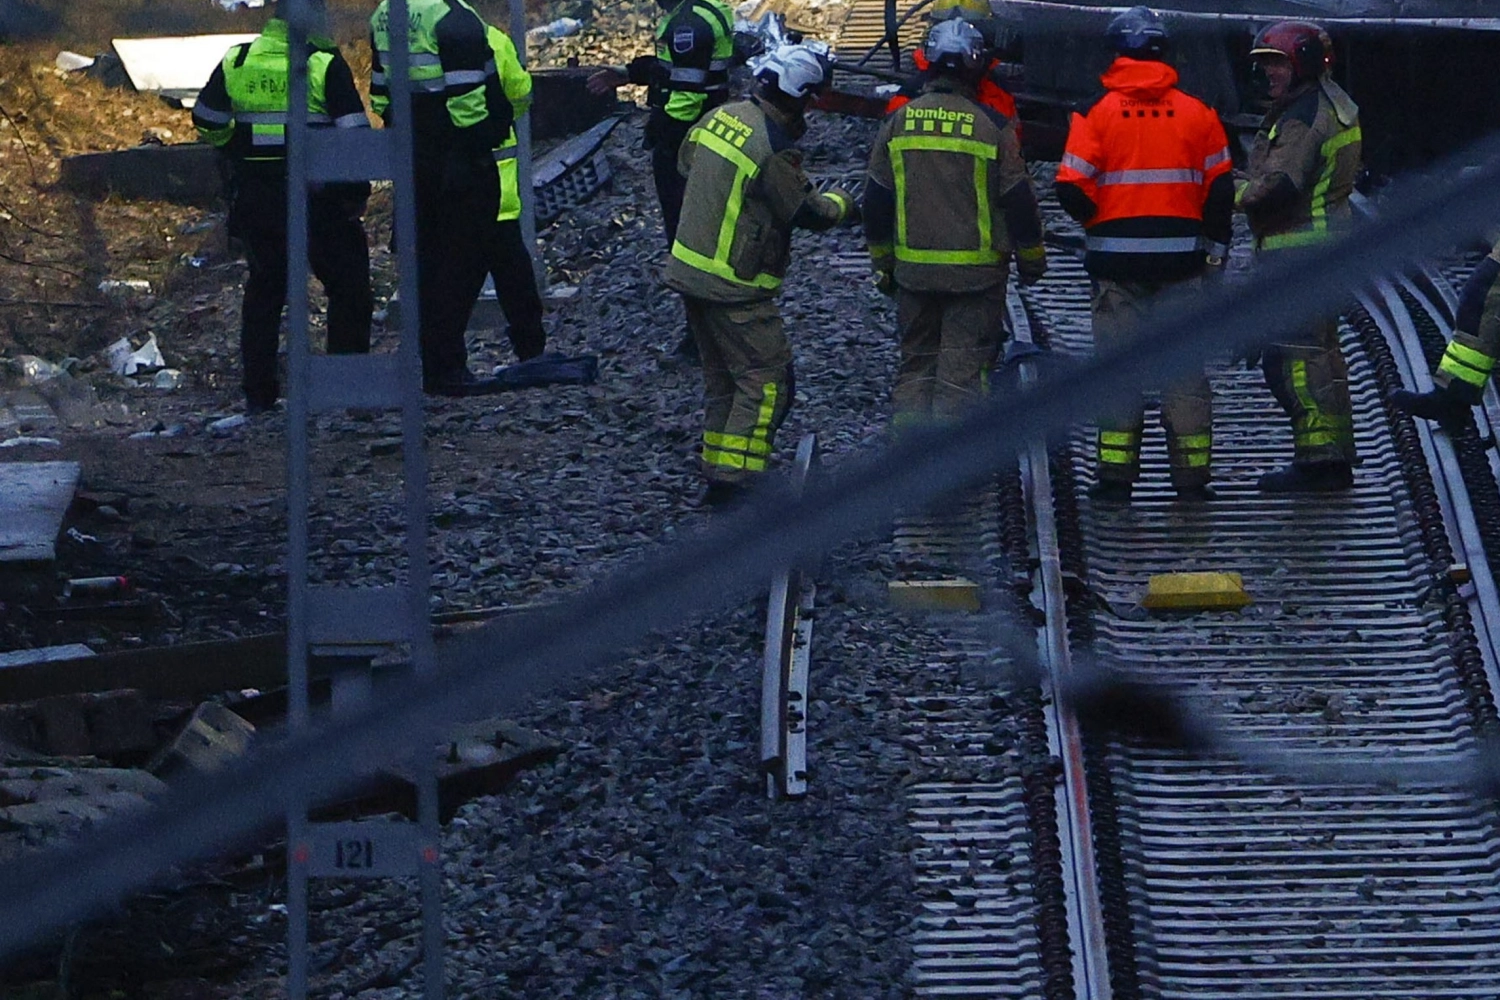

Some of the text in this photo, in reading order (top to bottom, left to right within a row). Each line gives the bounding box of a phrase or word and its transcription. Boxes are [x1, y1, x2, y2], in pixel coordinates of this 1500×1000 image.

[713, 107, 753, 138] bombers
[905, 105, 975, 124] bombers
[335, 839, 373, 869] 121
